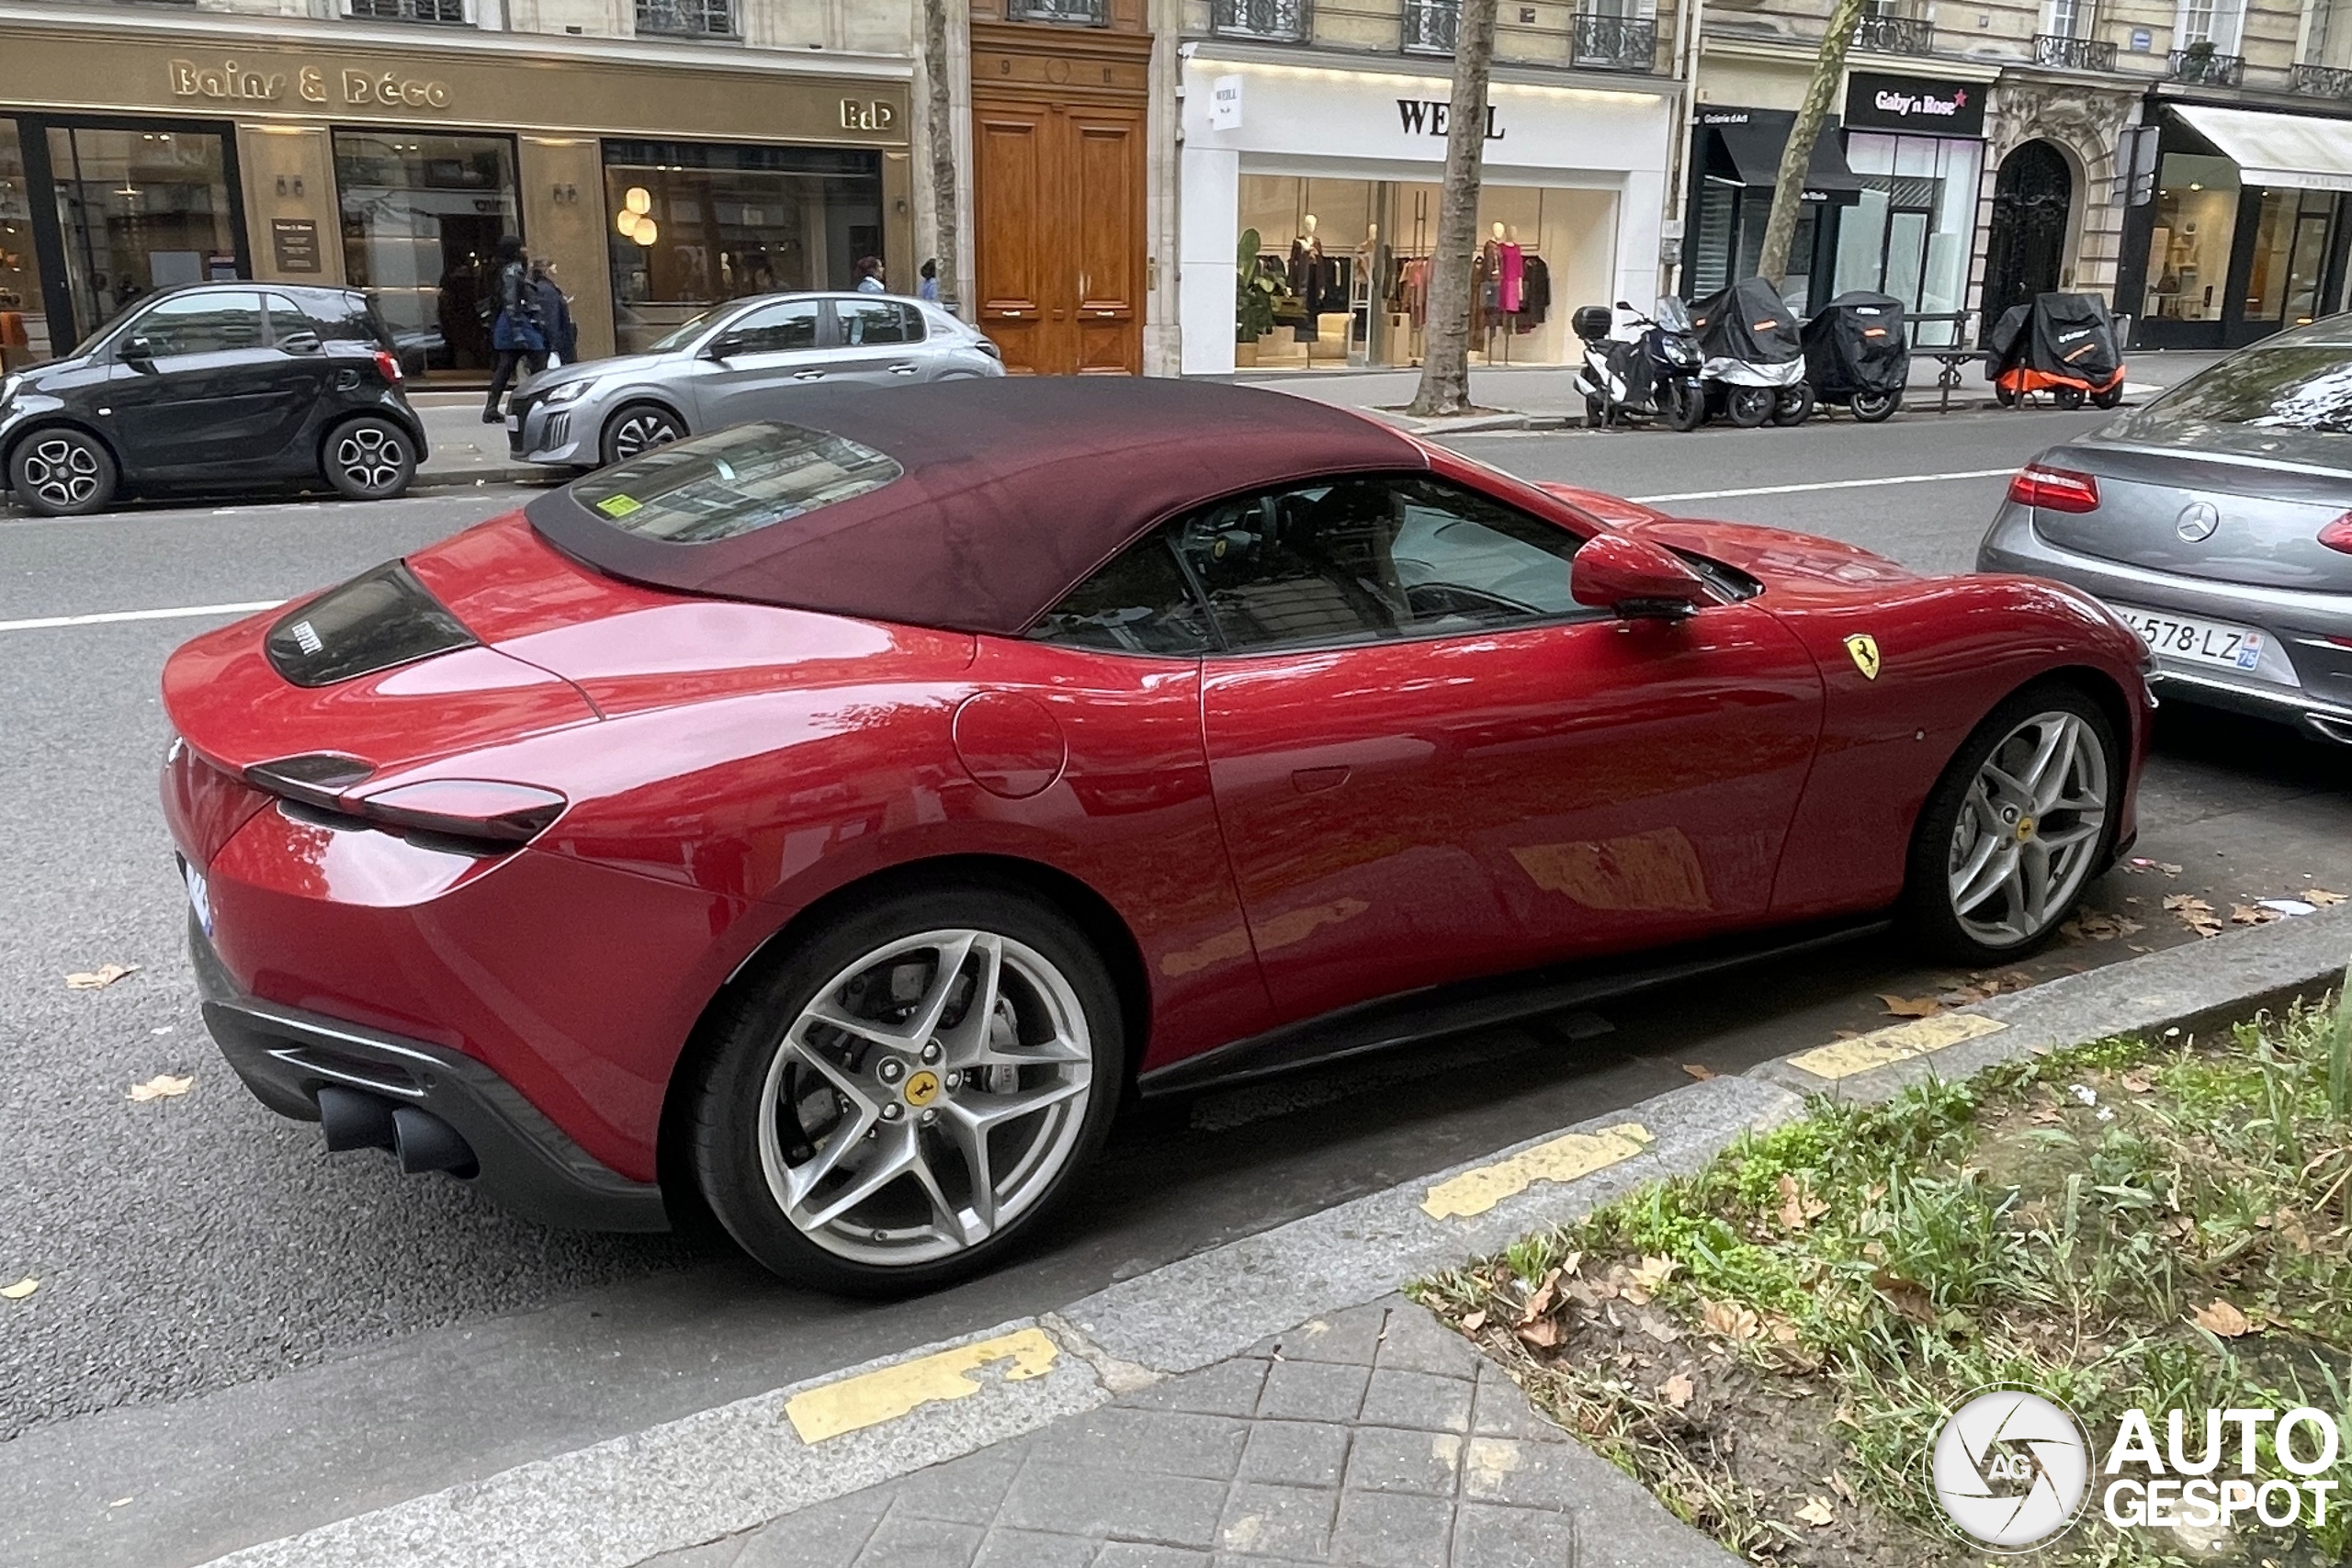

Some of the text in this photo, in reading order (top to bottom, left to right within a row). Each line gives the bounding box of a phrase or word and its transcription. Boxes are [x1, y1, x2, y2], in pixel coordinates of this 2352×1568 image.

[1001, 60, 1011, 75] 9
[169, 59, 453, 107] Bains & Déco
[1396, 99, 1506, 140] WEL
[1923, 96, 1956, 116] Rose
